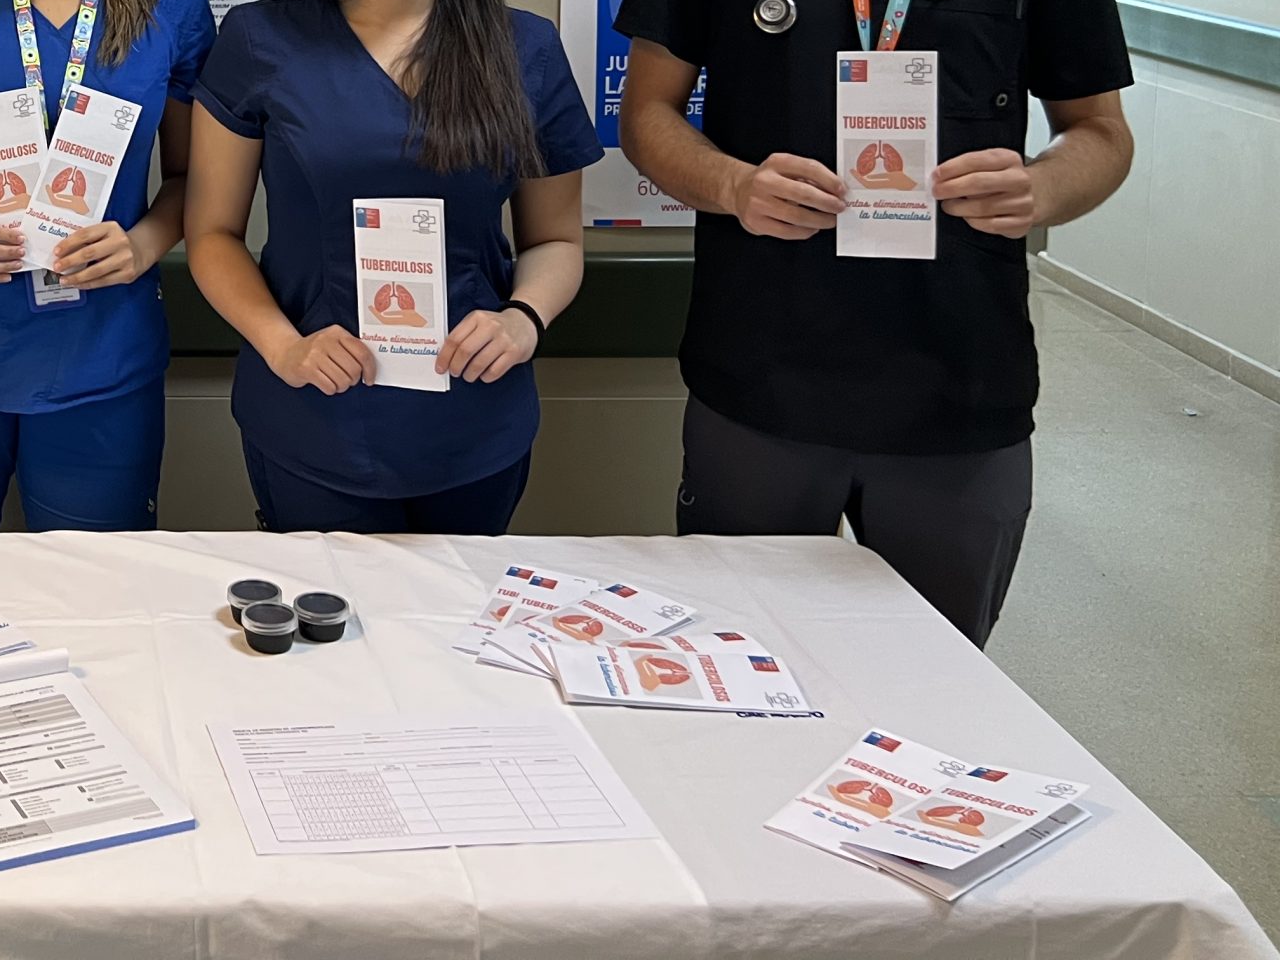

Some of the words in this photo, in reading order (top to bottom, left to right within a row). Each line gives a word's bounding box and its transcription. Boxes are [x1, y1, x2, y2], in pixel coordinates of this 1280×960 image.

[843, 116, 926, 129] TUBERCULOSIS
[55, 138, 115, 167] TUBERCULOSIS
[846, 199, 871, 208] untos
[873, 199, 928, 209] eliminamos
[26, 207, 50, 222] Juntos
[859, 210, 870, 219] la
[38, 222, 47, 232] la
[361, 258, 433, 274] TUBERCULOSIS
[362, 332, 388, 342] Juntos
[390, 335, 438, 344] eliminamos
[379, 344, 388, 352] la
[390, 345, 439, 355] tuberculosi
[578, 599, 647, 634] TUBERCULOSIS
[845, 758, 932, 795] TUBERCULOSI
[942, 787, 1038, 817] TUBERCULOSIS
